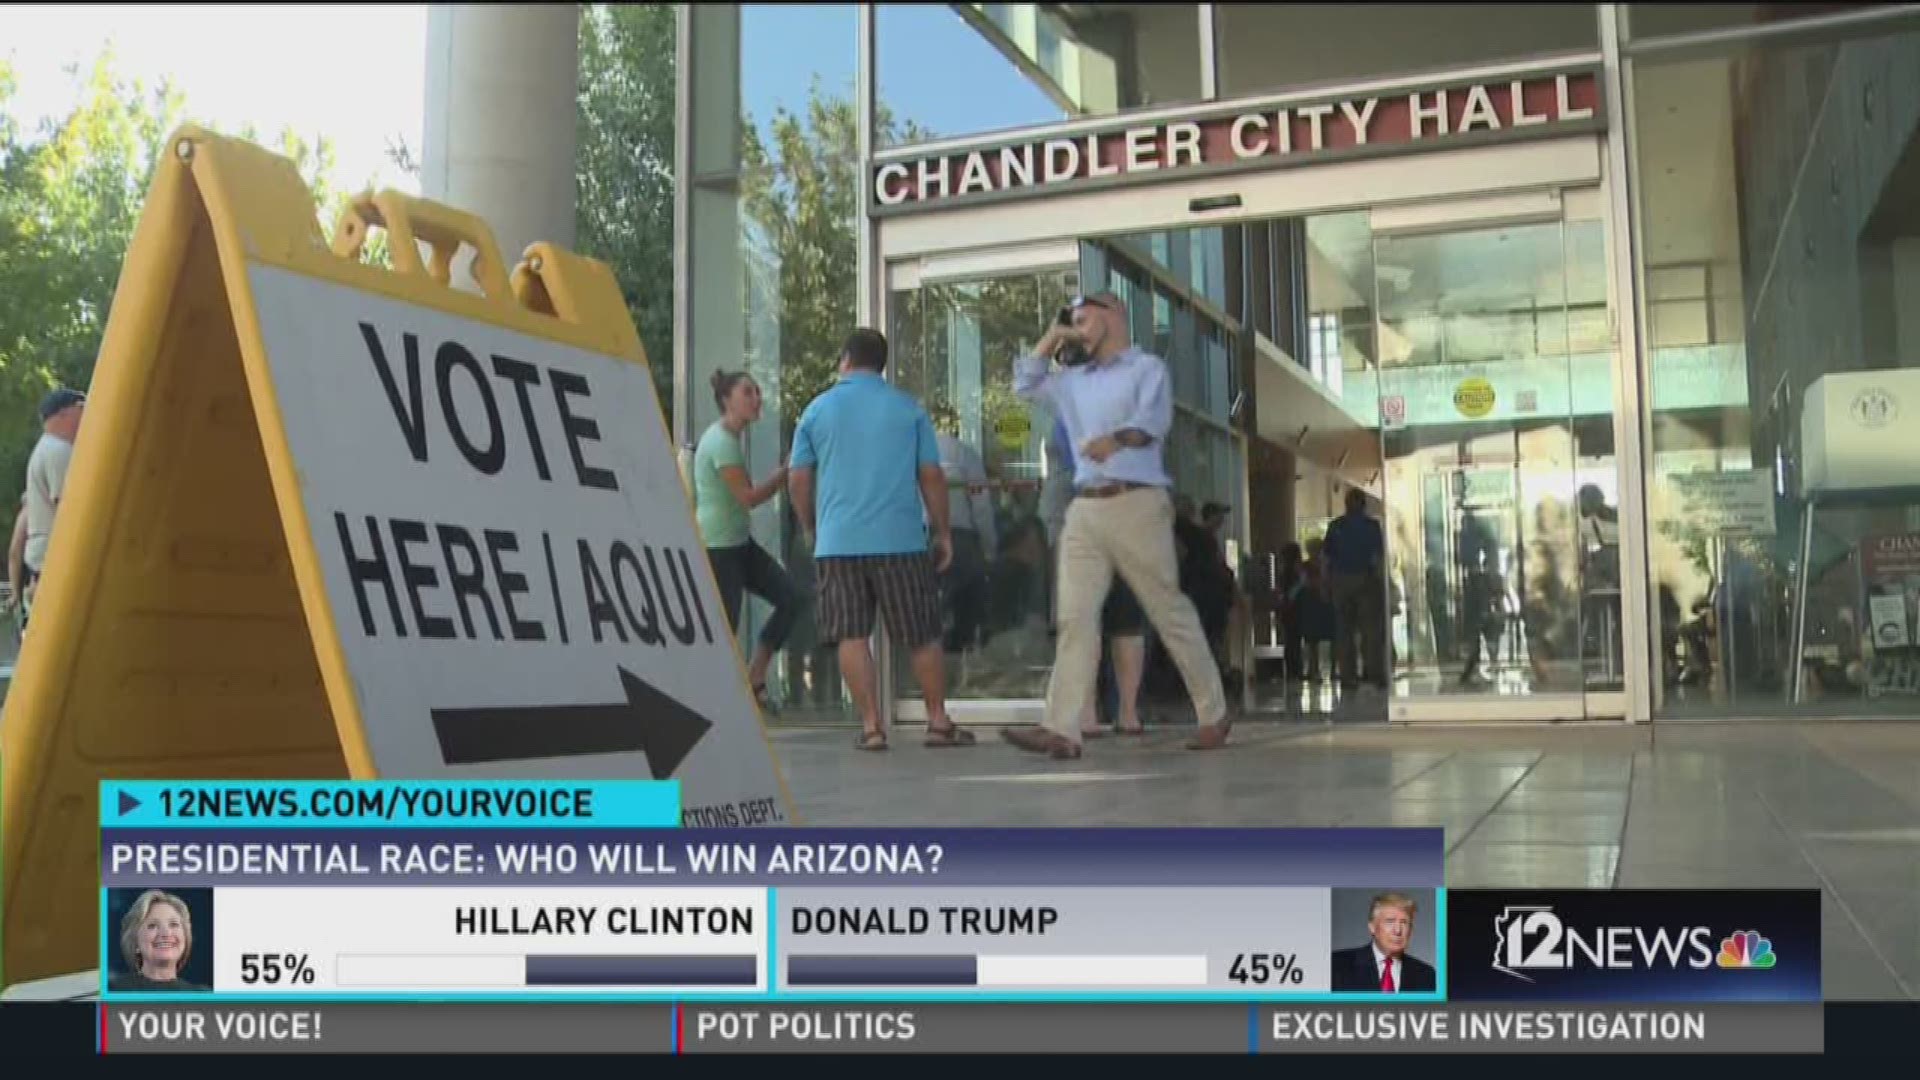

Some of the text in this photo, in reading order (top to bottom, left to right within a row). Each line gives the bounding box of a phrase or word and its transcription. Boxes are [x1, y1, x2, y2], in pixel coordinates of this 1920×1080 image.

[875, 73, 1593, 205] CHANDLER CITY HALL
[358, 322, 620, 491] VOTE
[334, 511, 546, 641] HERE
[576, 539, 715, 648] AQUI
[738, 797, 784, 826] DEPT.
